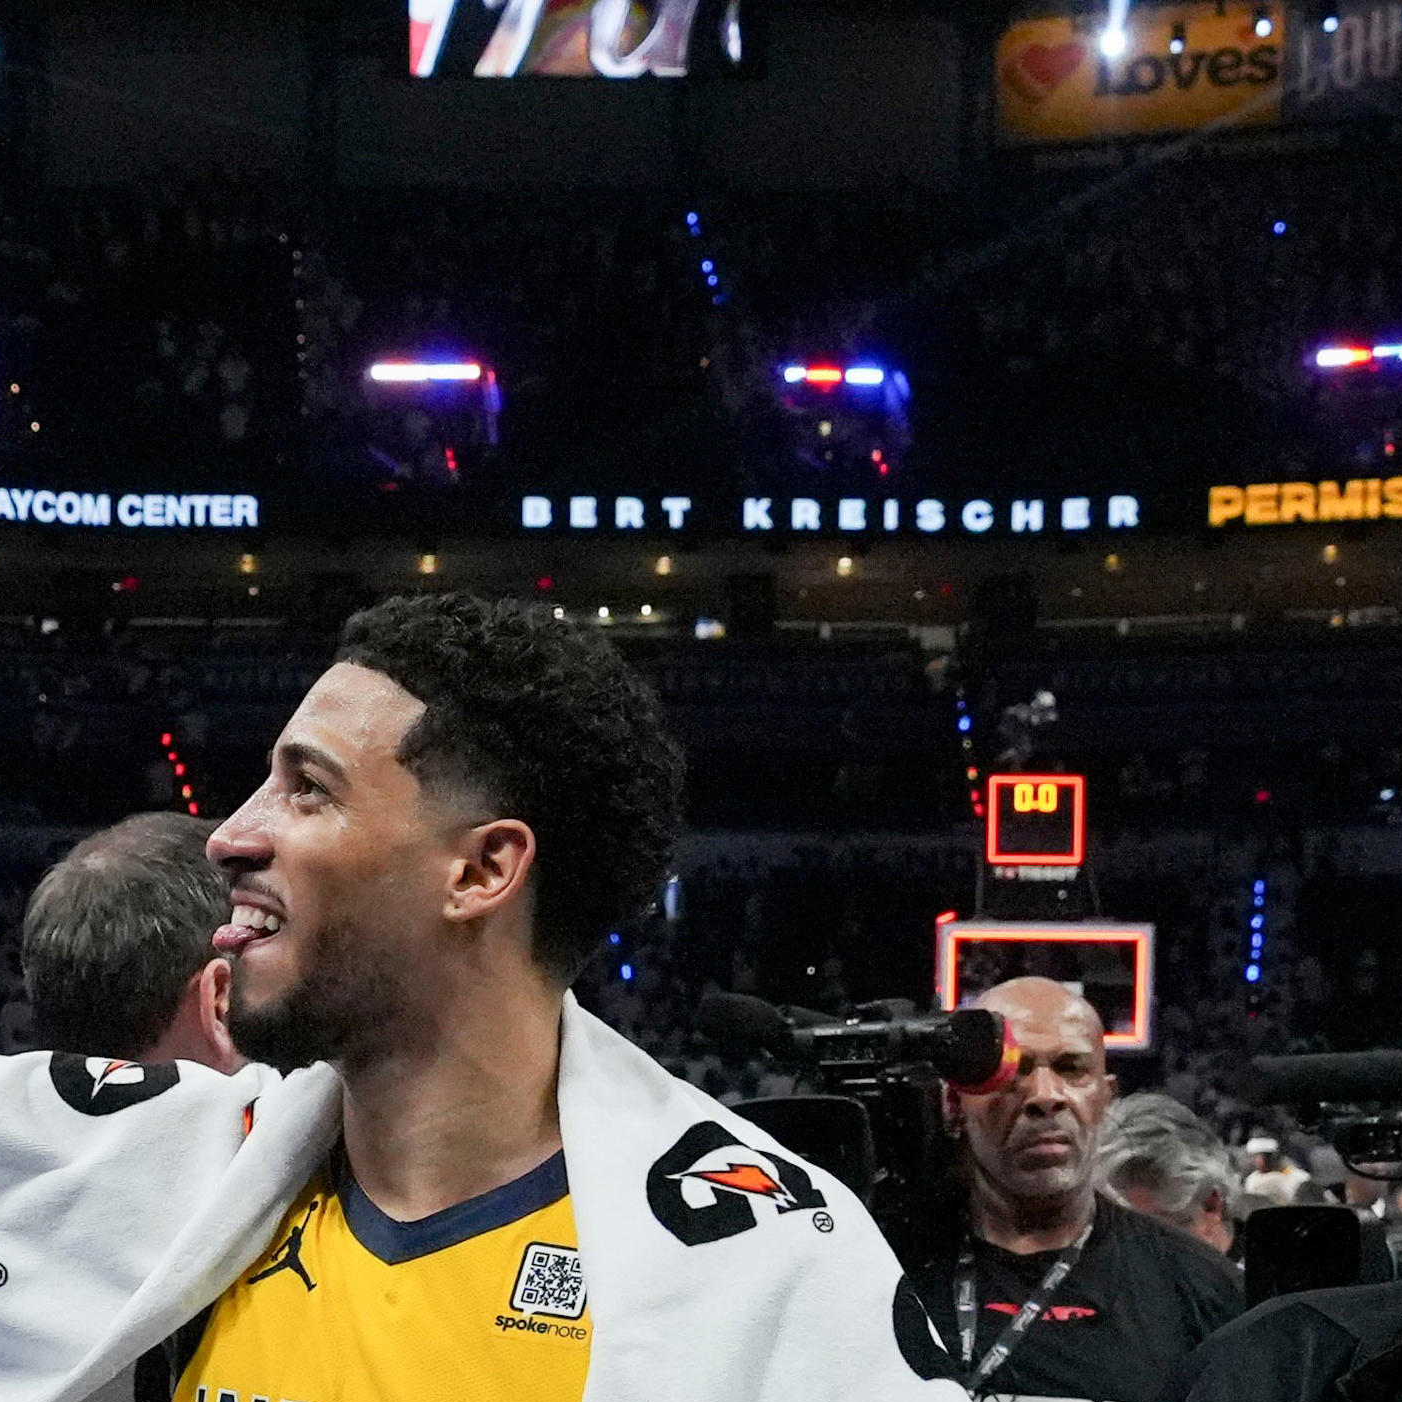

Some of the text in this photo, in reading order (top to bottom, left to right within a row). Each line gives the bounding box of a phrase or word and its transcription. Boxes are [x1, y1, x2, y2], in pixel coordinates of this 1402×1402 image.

[116, 494, 259, 528] CENTER
[521, 495, 1140, 533] BERT KREISCHER
[494, 1315, 588, 1341] spokenote
